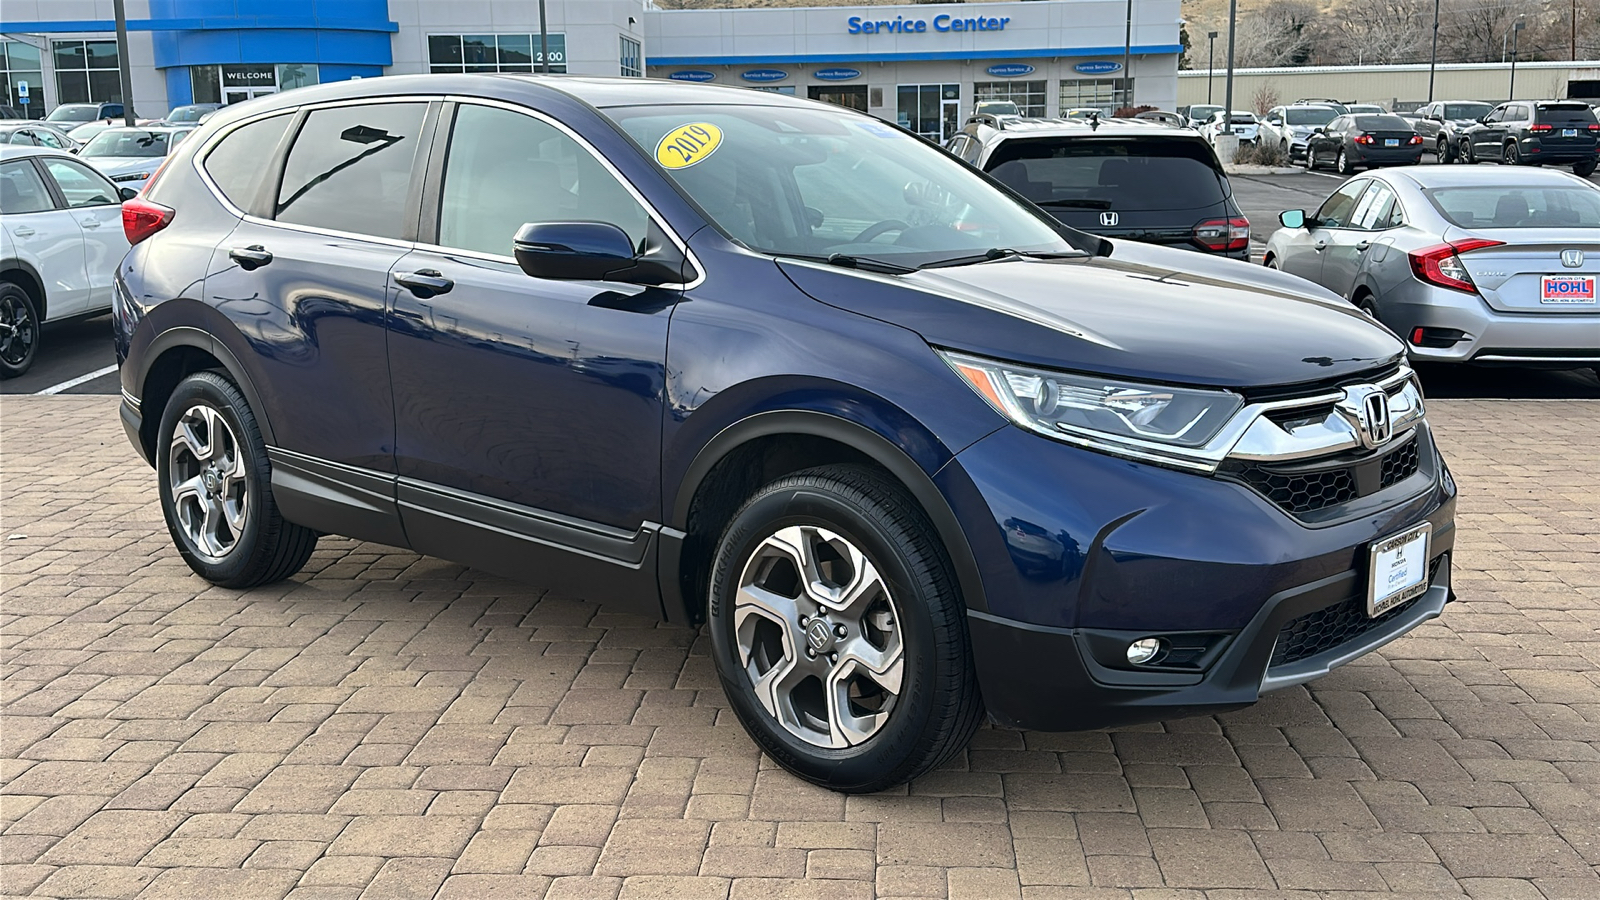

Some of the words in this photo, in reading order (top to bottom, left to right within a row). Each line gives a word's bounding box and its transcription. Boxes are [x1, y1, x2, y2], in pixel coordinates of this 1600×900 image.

[848, 15, 926, 34] Service
[933, 14, 1010, 32] Center
[536, 51, 563, 61] 200
[226, 72, 273, 80] WELCOME
[667, 125, 711, 163] 2019
[1547, 282, 1589, 292] HOHL
[1387, 534, 1407, 549] CARSON
[1407, 530, 1418, 541] CITY
[712, 525, 749, 617] BLACKHAWK
[1391, 558, 1406, 568] HONDA
[1388, 568, 1408, 583] Certified
[1373, 599, 1389, 613] MICHAEL
[1390, 594, 1401, 605] HOHL
[1402, 582, 1427, 599] AUTOMOTIVE
